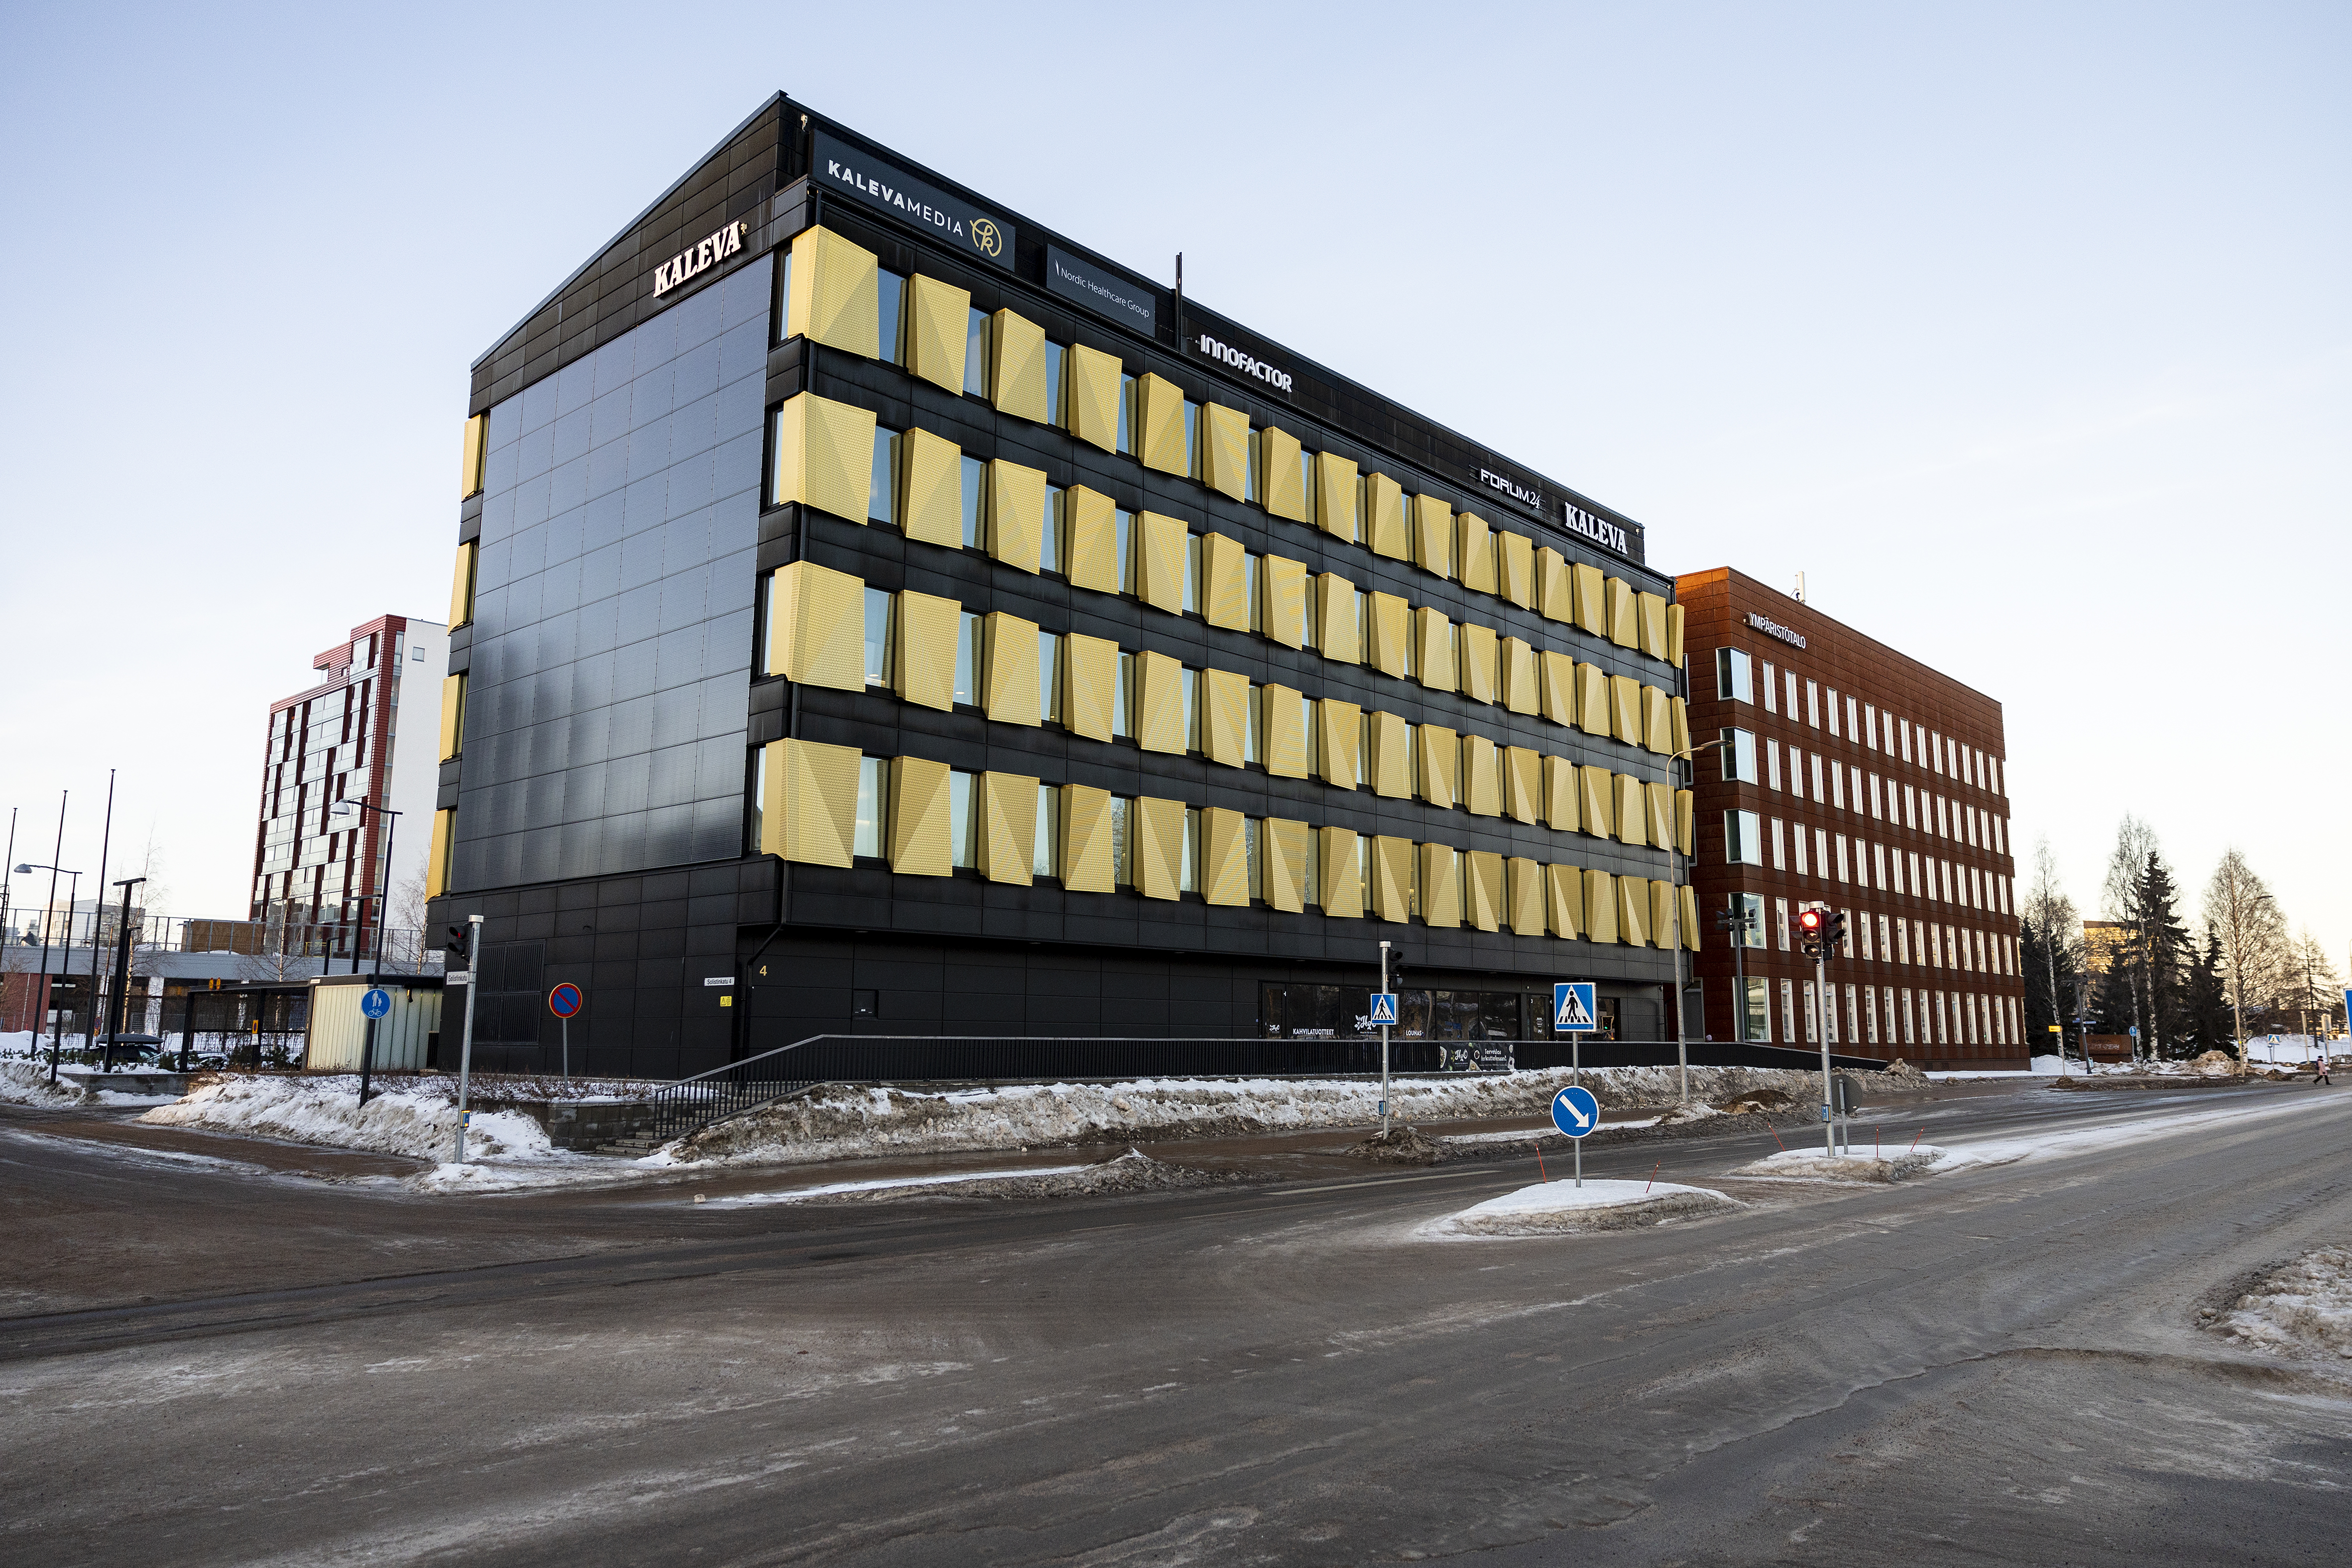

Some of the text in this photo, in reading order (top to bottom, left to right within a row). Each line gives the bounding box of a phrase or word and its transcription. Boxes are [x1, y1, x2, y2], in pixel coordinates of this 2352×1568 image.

[828, 159, 963, 237] KALEVAMEDIA
[653, 221, 741, 298] KALEVA
[1061, 267, 1150, 318] Nordic Healthcare Group
[1200, 334, 1293, 393] INNOFACTOR
[1565, 502, 1628, 555] KALEVA
[1749, 612, 1806, 649] YMPÄRISTÖTALO
[759, 965, 767, 976] 4
